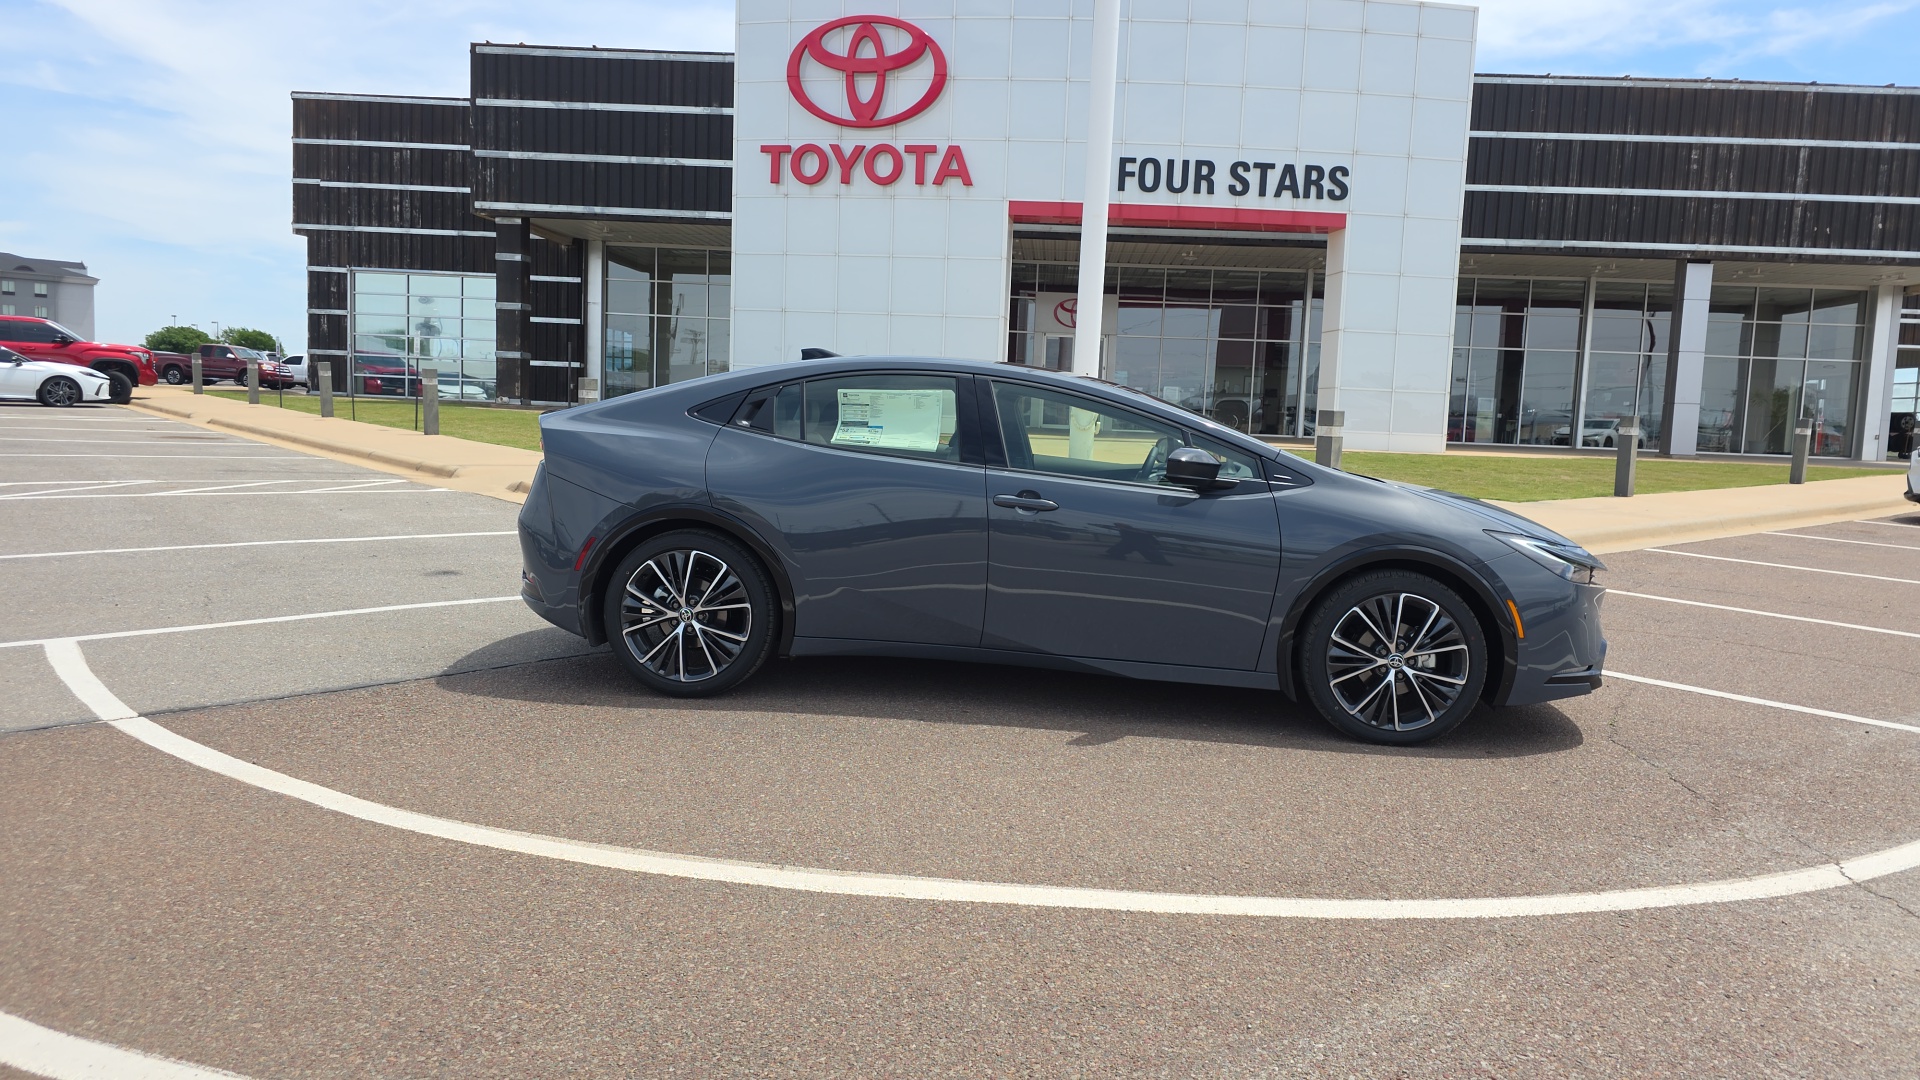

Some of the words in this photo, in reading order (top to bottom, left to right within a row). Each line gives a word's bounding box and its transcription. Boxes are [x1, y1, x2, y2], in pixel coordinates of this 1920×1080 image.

[761, 144, 973, 187] TOYOTA
[1117, 157, 1216, 195] FOUR
[1227, 160, 1350, 202] STARS
